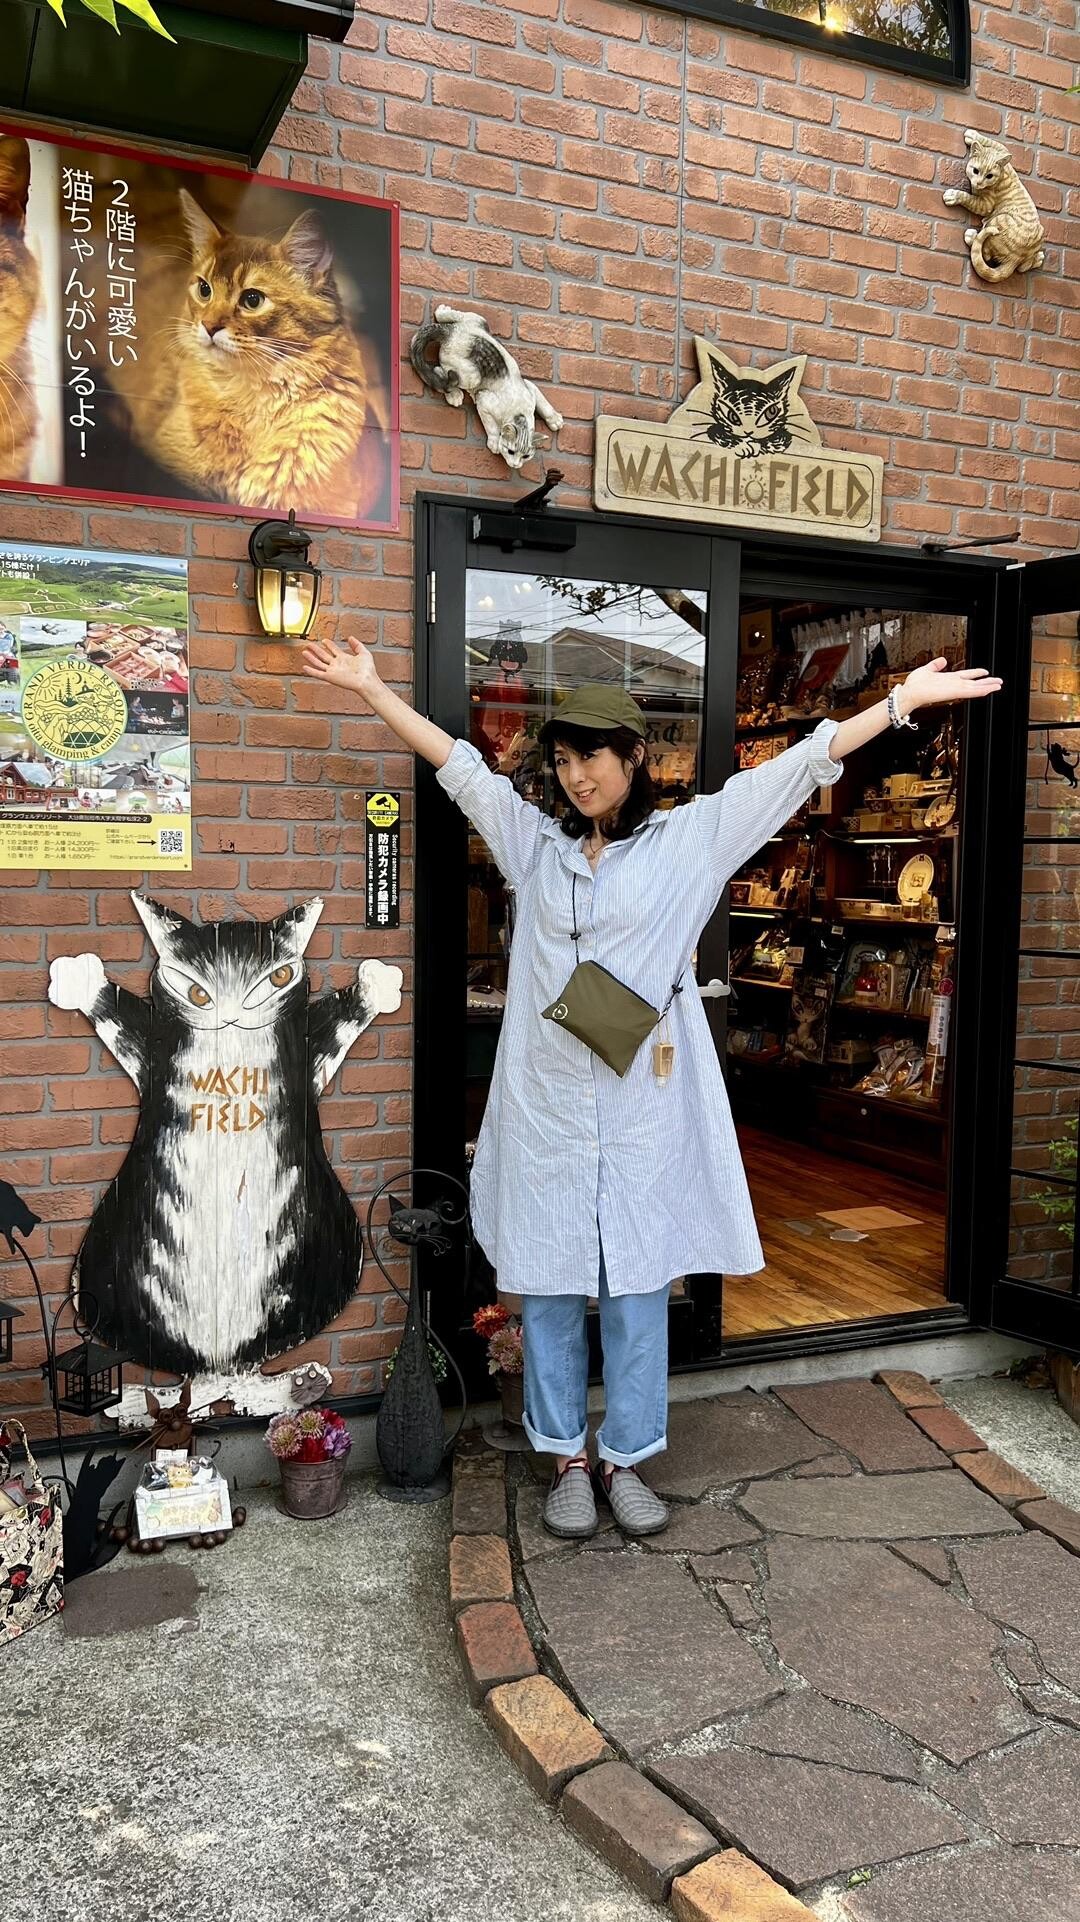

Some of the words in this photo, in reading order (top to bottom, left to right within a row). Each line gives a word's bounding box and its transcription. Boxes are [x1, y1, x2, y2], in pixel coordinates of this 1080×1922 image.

[106, 179, 139, 367] 2階に可愛い
[62, 166, 97, 458] 猫ちゃんがいるよ！
[612, 440, 741, 507] WACHI
[768, 460, 870, 521] FIELD
[25, 673, 44, 722] GRAND
[47, 660, 96, 675] VERDE
[100, 673, 124, 725] RESORT
[29, 722, 45, 744] oita
[43, 739, 89, 760] glamping
[90, 745, 100, 756] &
[101, 726, 121, 751] camp
[377, 833, 389, 925] 防犯カメラ録画中
[187, 1066, 268, 1096] WACHI
[190, 1100, 266, 1134] FIELD
